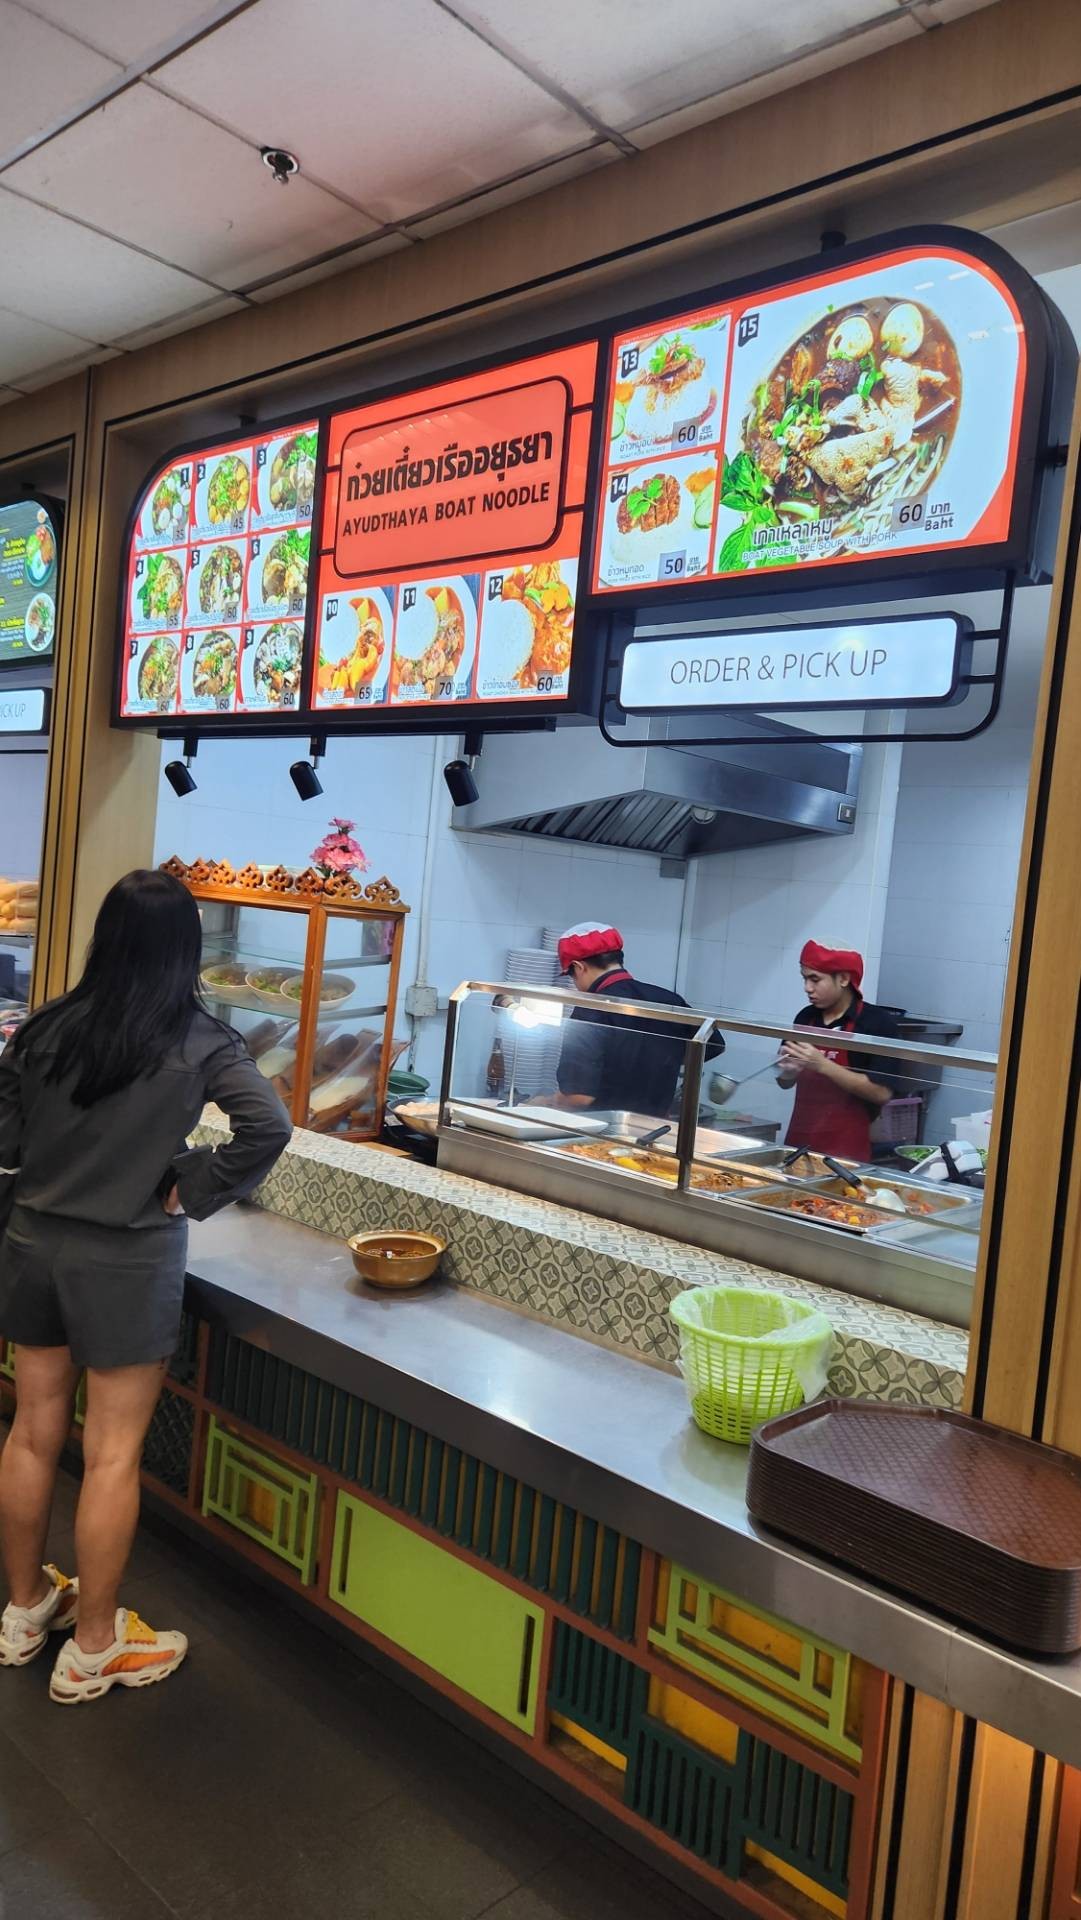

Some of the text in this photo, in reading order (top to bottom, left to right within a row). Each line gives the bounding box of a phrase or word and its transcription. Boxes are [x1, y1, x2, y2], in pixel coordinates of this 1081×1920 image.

[740, 316, 758, 338] 15
[623, 353, 638, 371] 13
[678, 424, 696, 443] 60
[259, 451, 266, 463] 3
[198, 466, 205, 478] 2
[346, 431, 553, 502] ก๋วยเตี๋ยวเรืออยุธยา
[612, 476, 628, 494] 14
[299, 505, 311, 518] 50
[343, 482, 551, 537] AYUDTHAYA BOAT NOODLE
[899, 503, 922, 524] 60
[930, 502, 951, 514] บาท
[233, 518, 244, 530] 45
[925, 516, 954, 531] Baht
[753, 519, 833, 545] เกาเหลาหมู
[253, 541, 260, 554] 6
[743, 550, 764, 561] BOAT
[767, 543, 816, 557] VEGETABLE
[819, 539, 843, 550] SOUP
[193, 551, 199, 563] 5
[664, 557, 683, 574] 50
[490, 578, 502, 595] 12
[404, 590, 416, 605] 11
[293, 599, 304, 611] 60
[327, 601, 338, 617] 10
[227, 607, 237, 619] 60
[169, 615, 179, 627] 55
[187, 637, 194, 649] 8
[247, 630, 254, 643] 9
[670, 648, 888, 685] ORDER & PICK UP
[439, 681, 452, 695] 70
[536, 676, 553, 691] 60
[284, 692, 295, 705] 60
[359, 686, 372, 700] 65
[0, 703, 13, 719] ICK
[160, 701, 170, 712] 60
[219, 698, 229, 710] 60
